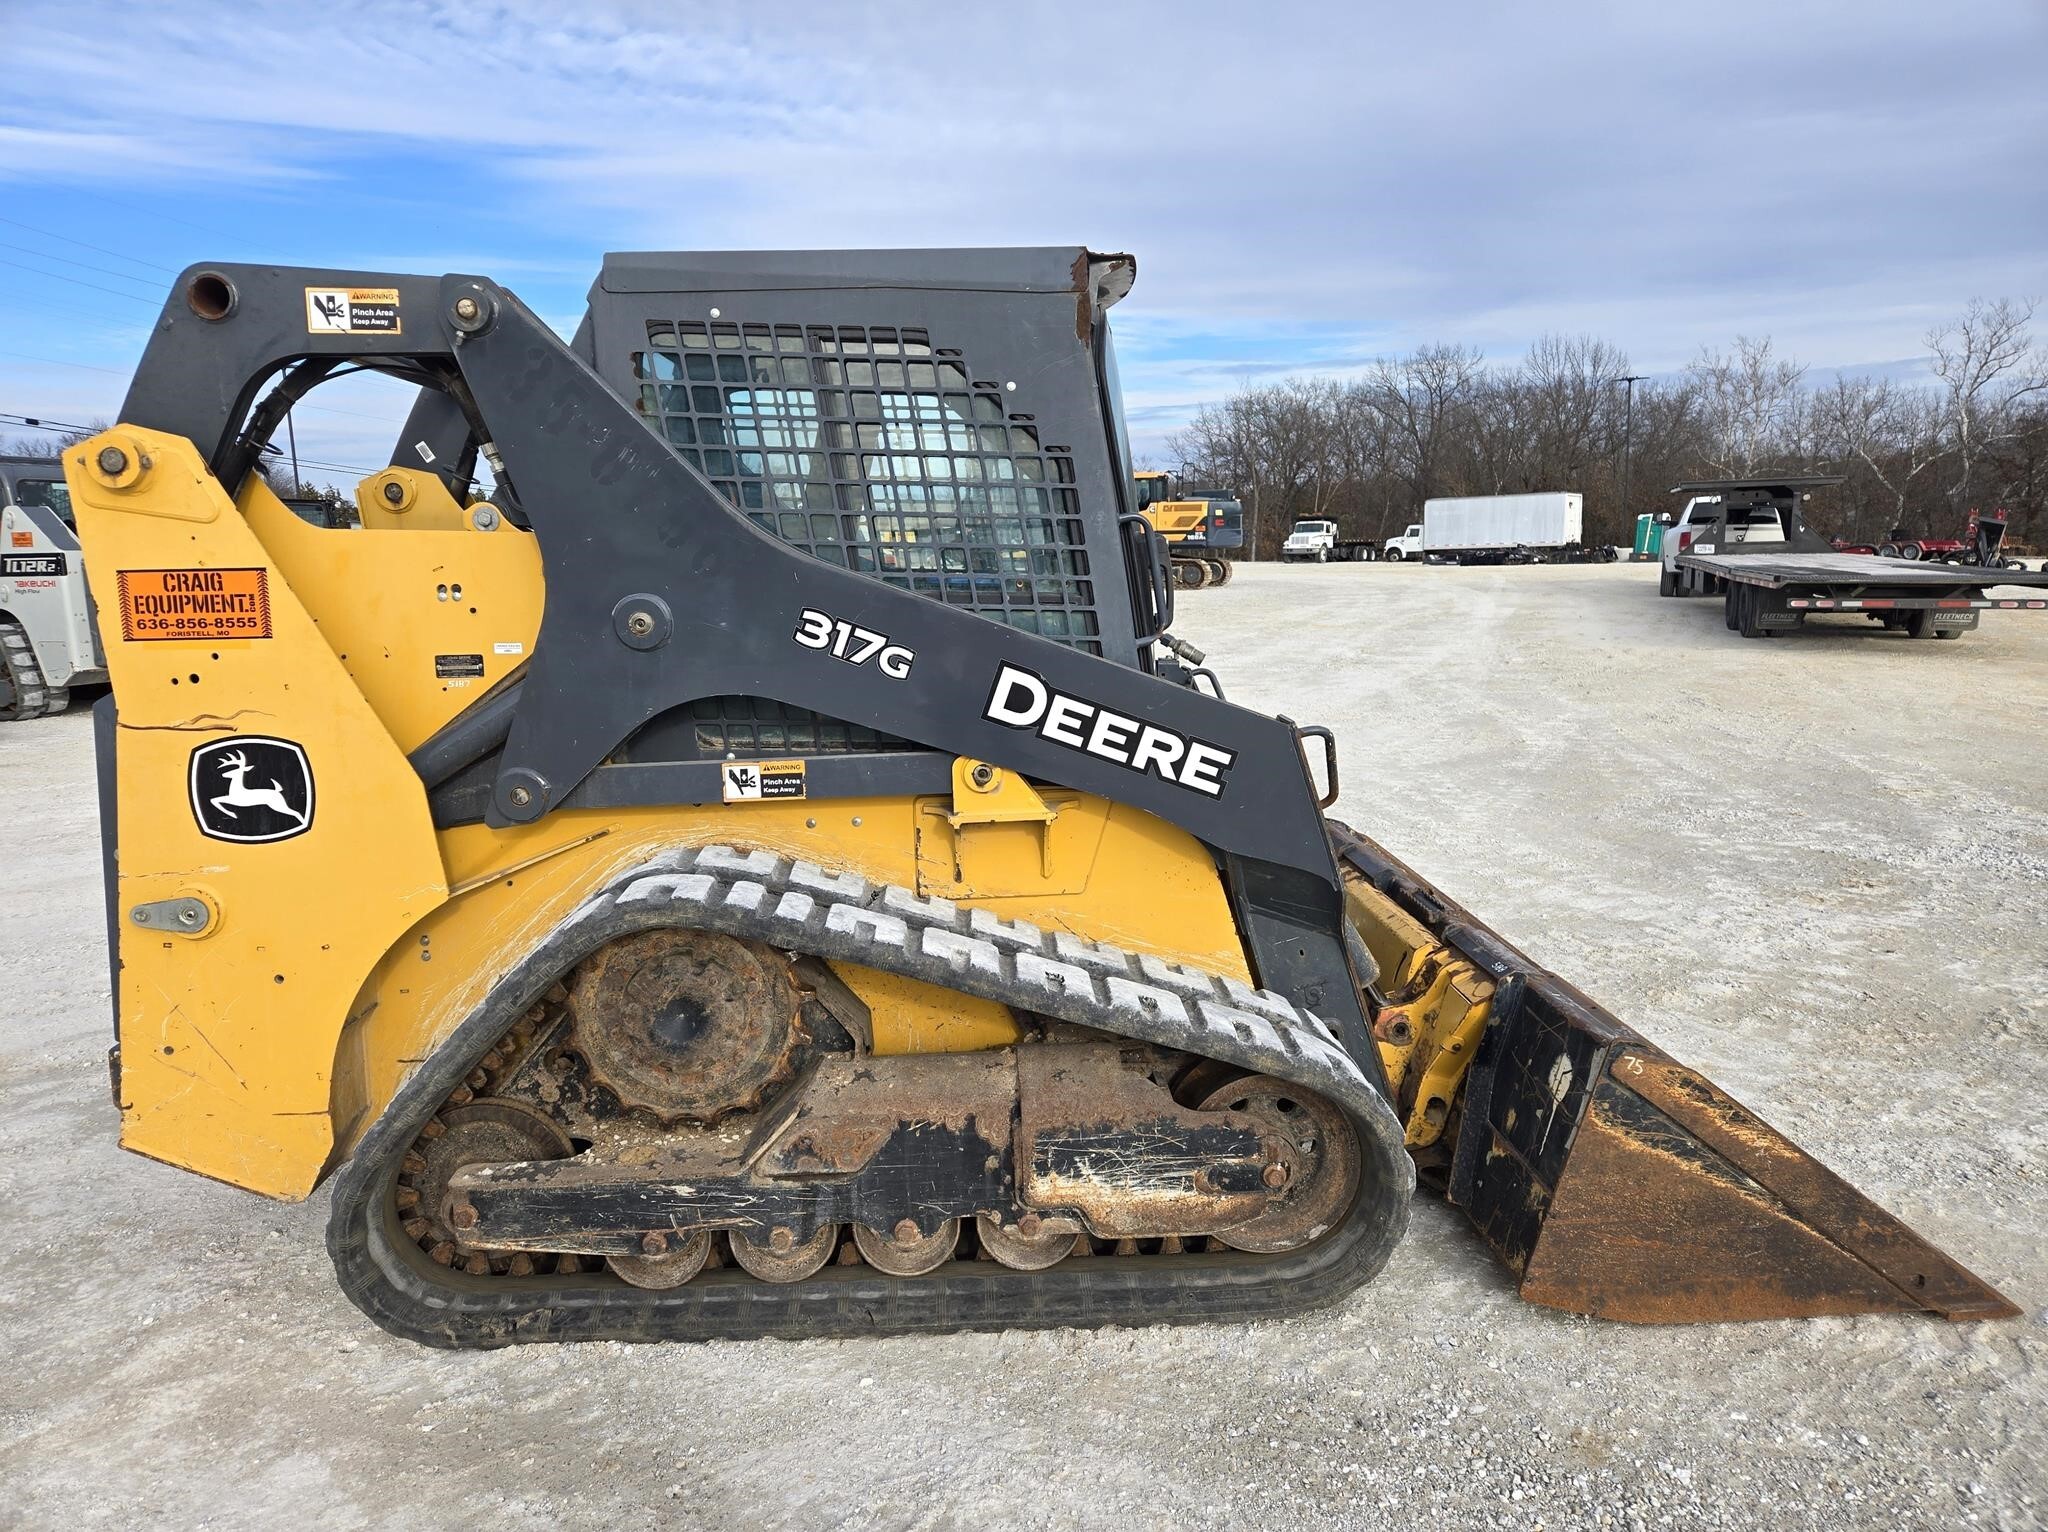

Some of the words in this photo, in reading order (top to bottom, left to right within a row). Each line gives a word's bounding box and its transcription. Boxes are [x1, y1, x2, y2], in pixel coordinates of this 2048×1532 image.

[352, 308, 374, 317] Pinch
[375, 309, 394, 317] Area
[353, 318, 370, 326] Keep
[371, 319, 389, 327] Away
[162, 572, 224, 593] CRAIG
[136, 617, 258, 630] 636-856-8555
[1934, 612, 1976, 620] FLEETNECK
[794, 609, 916, 680] 317G
[986, 665, 1232, 796] DEERE
[1623, 1056, 1645, 1075] 75
